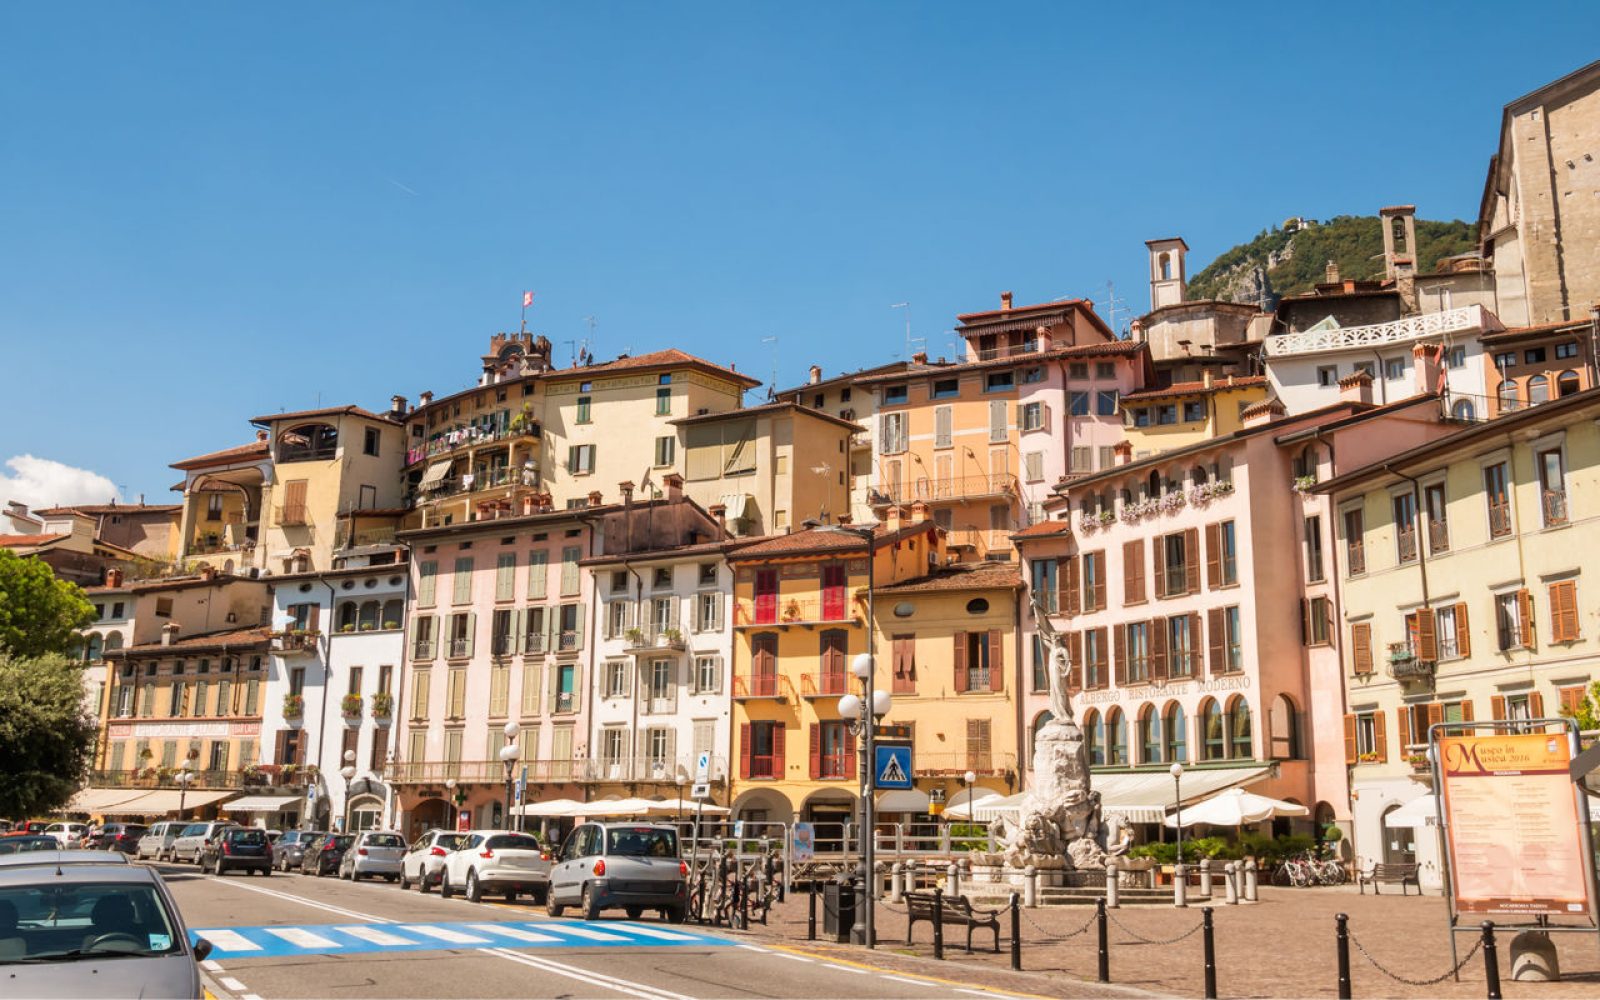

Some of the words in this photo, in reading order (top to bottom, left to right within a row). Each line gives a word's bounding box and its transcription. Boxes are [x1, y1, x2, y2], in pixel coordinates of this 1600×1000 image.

[1079, 690, 1121, 705] ALBERGO
[1128, 684, 1189, 700] RISTORANTE
[1197, 676, 1251, 693] MODERNO
